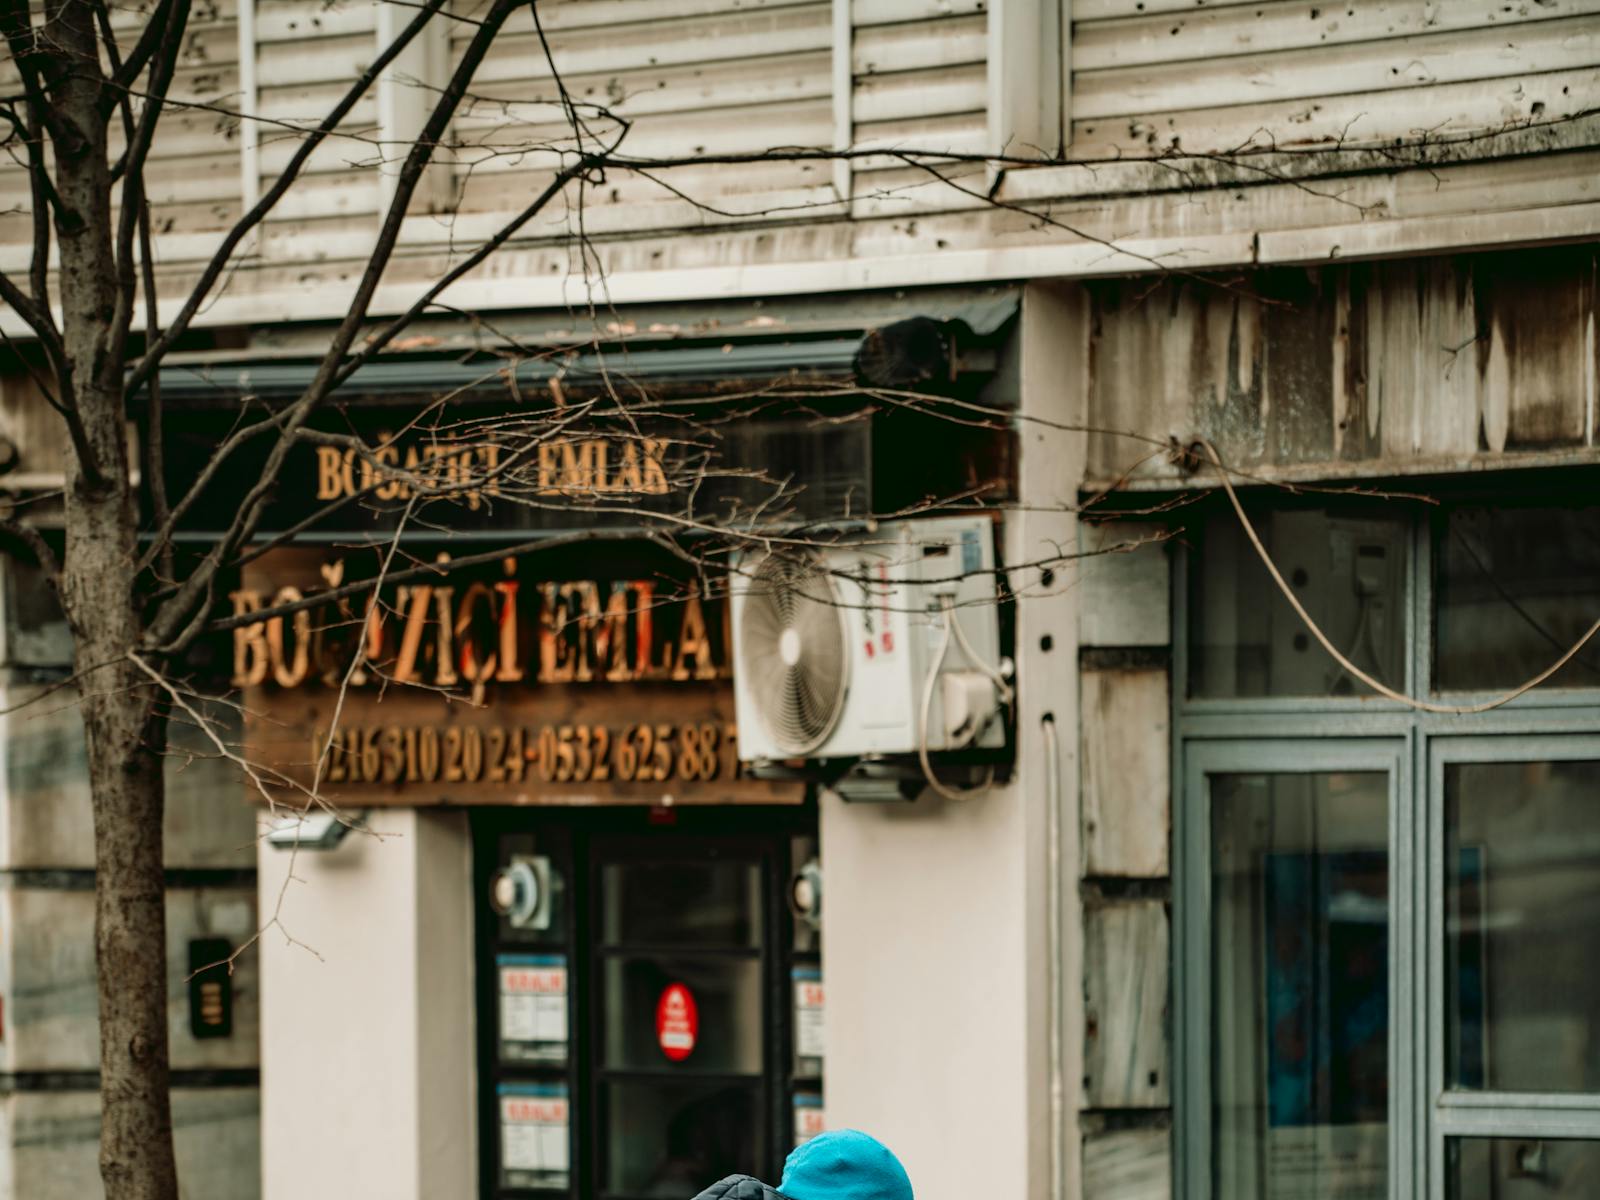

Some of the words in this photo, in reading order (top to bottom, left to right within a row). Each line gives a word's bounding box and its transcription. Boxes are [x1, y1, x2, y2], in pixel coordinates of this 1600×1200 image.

[536, 436, 670, 496] EMLAK
[536, 577, 733, 684] EMLA
[312, 724, 381, 783] 0216
[383, 724, 438, 783] 310
[445, 724, 482, 783] 20
[617, 722, 673, 782] 625
[678, 722, 718, 782] 88
